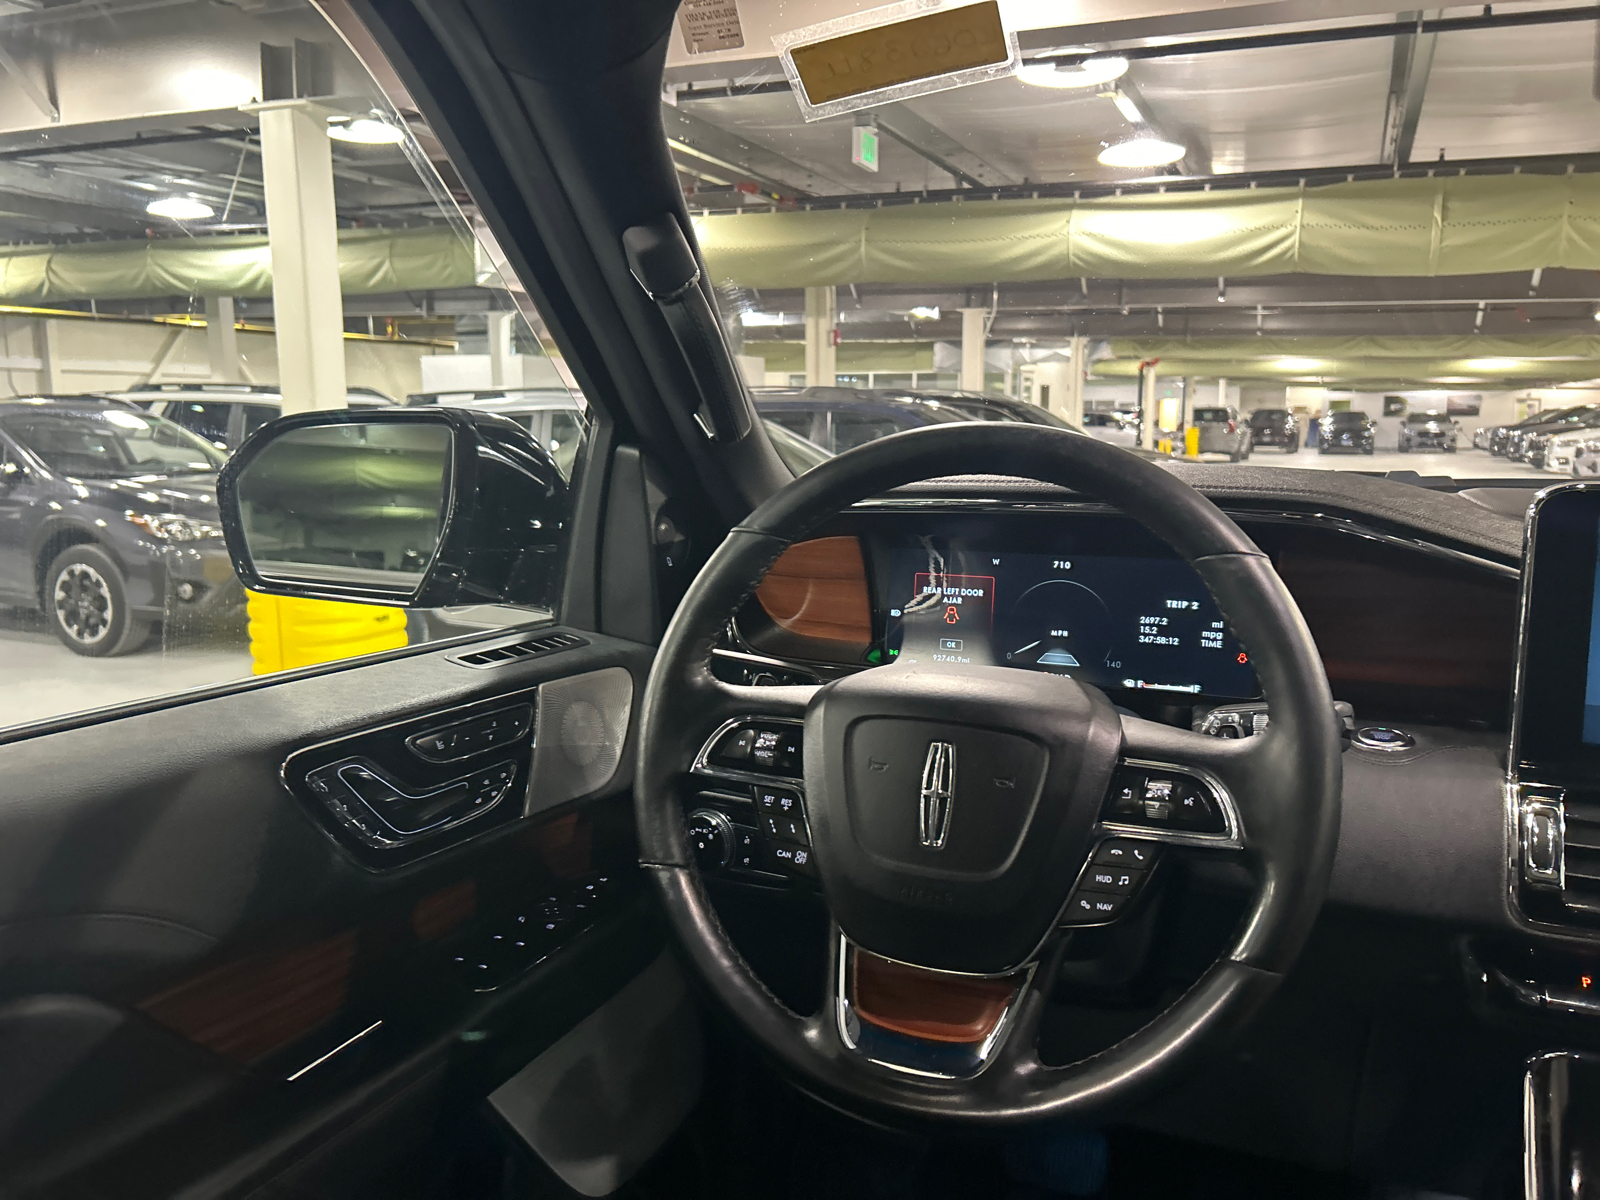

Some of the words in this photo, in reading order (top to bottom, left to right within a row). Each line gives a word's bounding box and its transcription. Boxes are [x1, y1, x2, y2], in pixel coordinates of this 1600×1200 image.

[1053, 560, 1071, 569] 710
[1166, 599, 1188, 608] TRIP
[1191, 601, 1200, 610] 2
[1139, 616, 1168, 625] 2697.2
[1139, 625, 1157, 634] 15.2
[1138, 635, 1179, 645] 347:58:12
[1200, 639, 1222, 648] TIME
[776, 849, 791, 858] CAN
[1095, 874, 1112, 883] HUD
[1096, 902, 1112, 911] NAV
[1581, 976, 1591, 987] P
